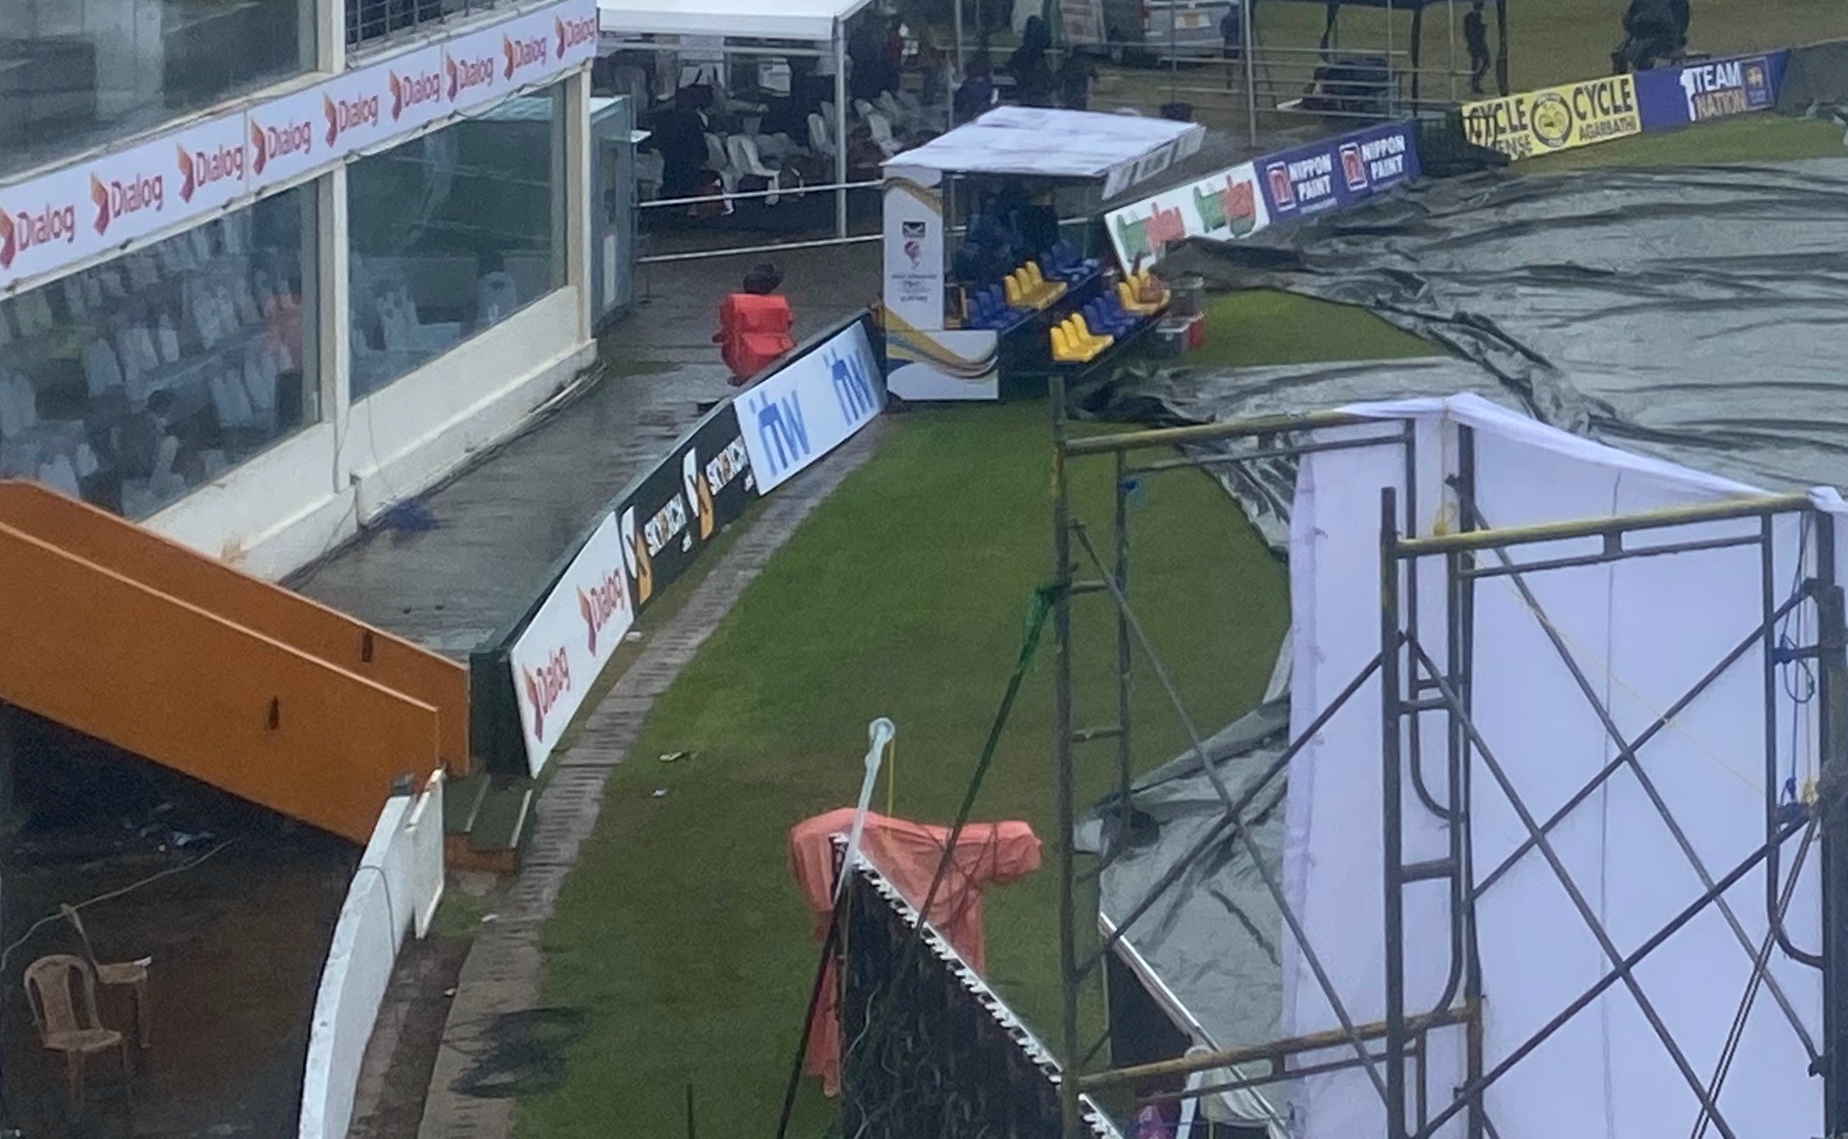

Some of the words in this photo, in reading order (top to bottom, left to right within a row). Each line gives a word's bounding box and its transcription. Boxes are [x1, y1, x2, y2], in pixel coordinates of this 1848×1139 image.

[565, 16, 595, 47] Dialog
[513, 37, 547, 68] Dialog
[402, 71, 440, 107] Dialog
[457, 56, 494, 90] Dialog
[337, 93, 379, 132] Dialog
[1573, 78, 1633, 121] CYCLE
[1694, 88, 1746, 121] NATION
[267, 119, 311, 158] Dialog
[1361, 135, 1405, 162] NIPPON
[196, 144, 243, 187] Dialog
[1288, 153, 1332, 182] NIPPON
[1371, 155, 1403, 180] PAINT
[110, 172, 163, 218] Dialog
[1298, 175, 1331, 202] PAINT
[16, 202, 75, 251] Dialog
[590, 568, 625, 632] Dialog
[536, 645, 570, 714] Dialog
